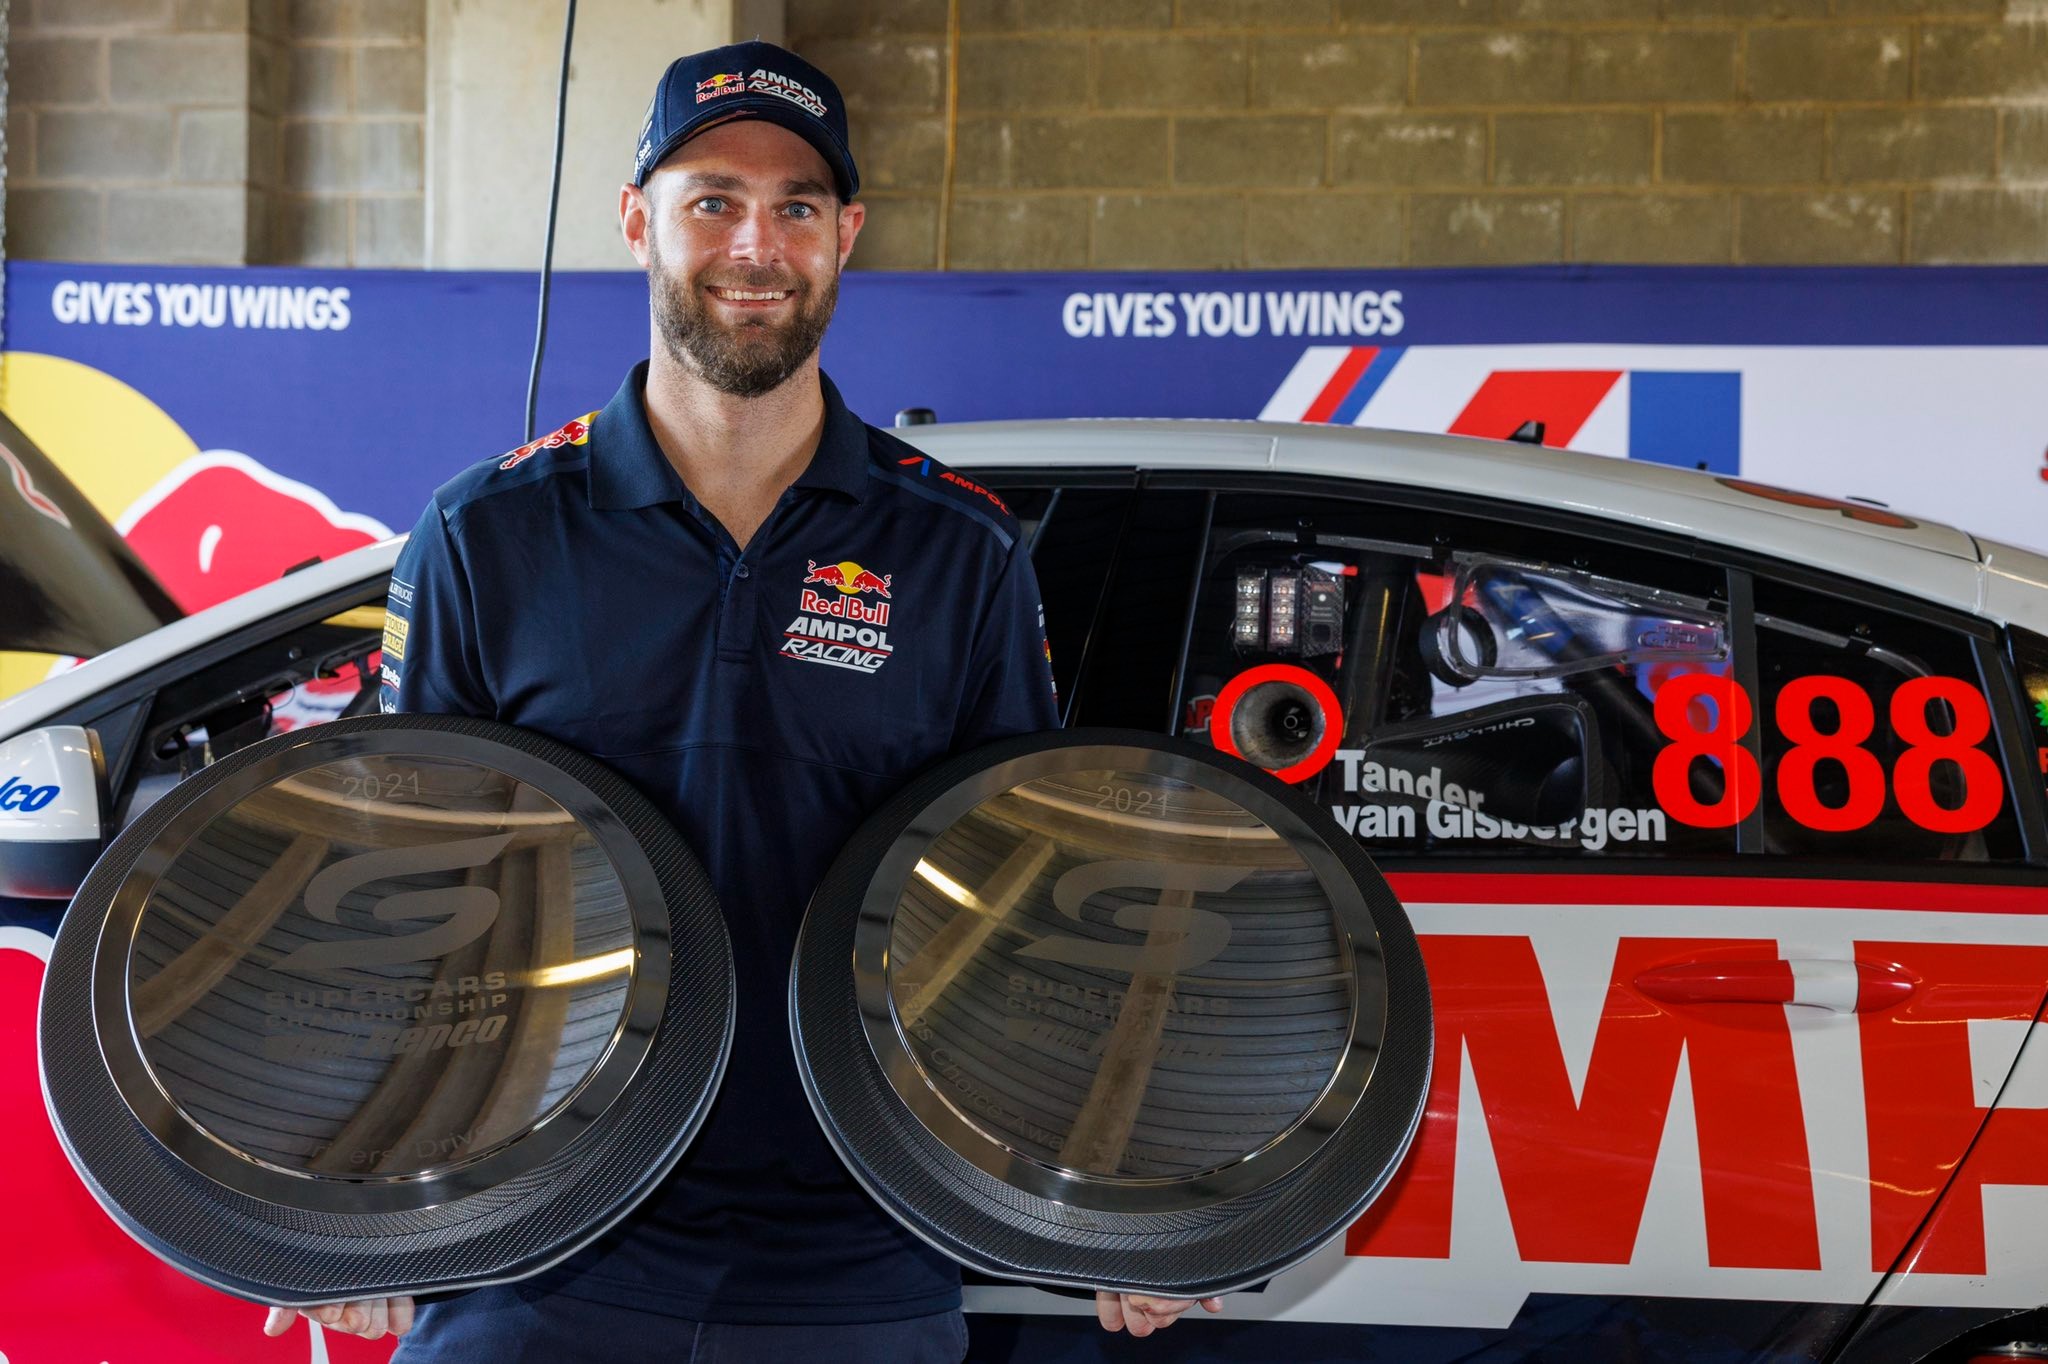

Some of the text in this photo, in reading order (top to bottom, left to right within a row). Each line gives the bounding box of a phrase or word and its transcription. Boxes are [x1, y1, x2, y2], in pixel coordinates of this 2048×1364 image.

[696, 82, 745, 104] Red Bull
[748, 81, 826, 116] RACING
[749, 69, 828, 111] AMPOL
[51, 280, 351, 331] GIVES YOU WINGS
[1062, 289, 1405, 338] GIVES YOU WINGS
[939, 472, 1010, 516] AMPOL
[800, 588, 890, 627] Red Bull
[785, 616, 894, 652] AMPOL
[781, 638, 888, 669] RACING
[1652, 673, 2004, 833] 888
[342, 771, 419, 799] 2021
[1335, 749, 1484, 812] Tander
[1096, 785, 1168, 816] 2021
[1332, 804, 1415, 838] van
[264, 971, 507, 1008] SUPERCARS
[264, 993, 508, 1028] CHAMPIONSHIP
